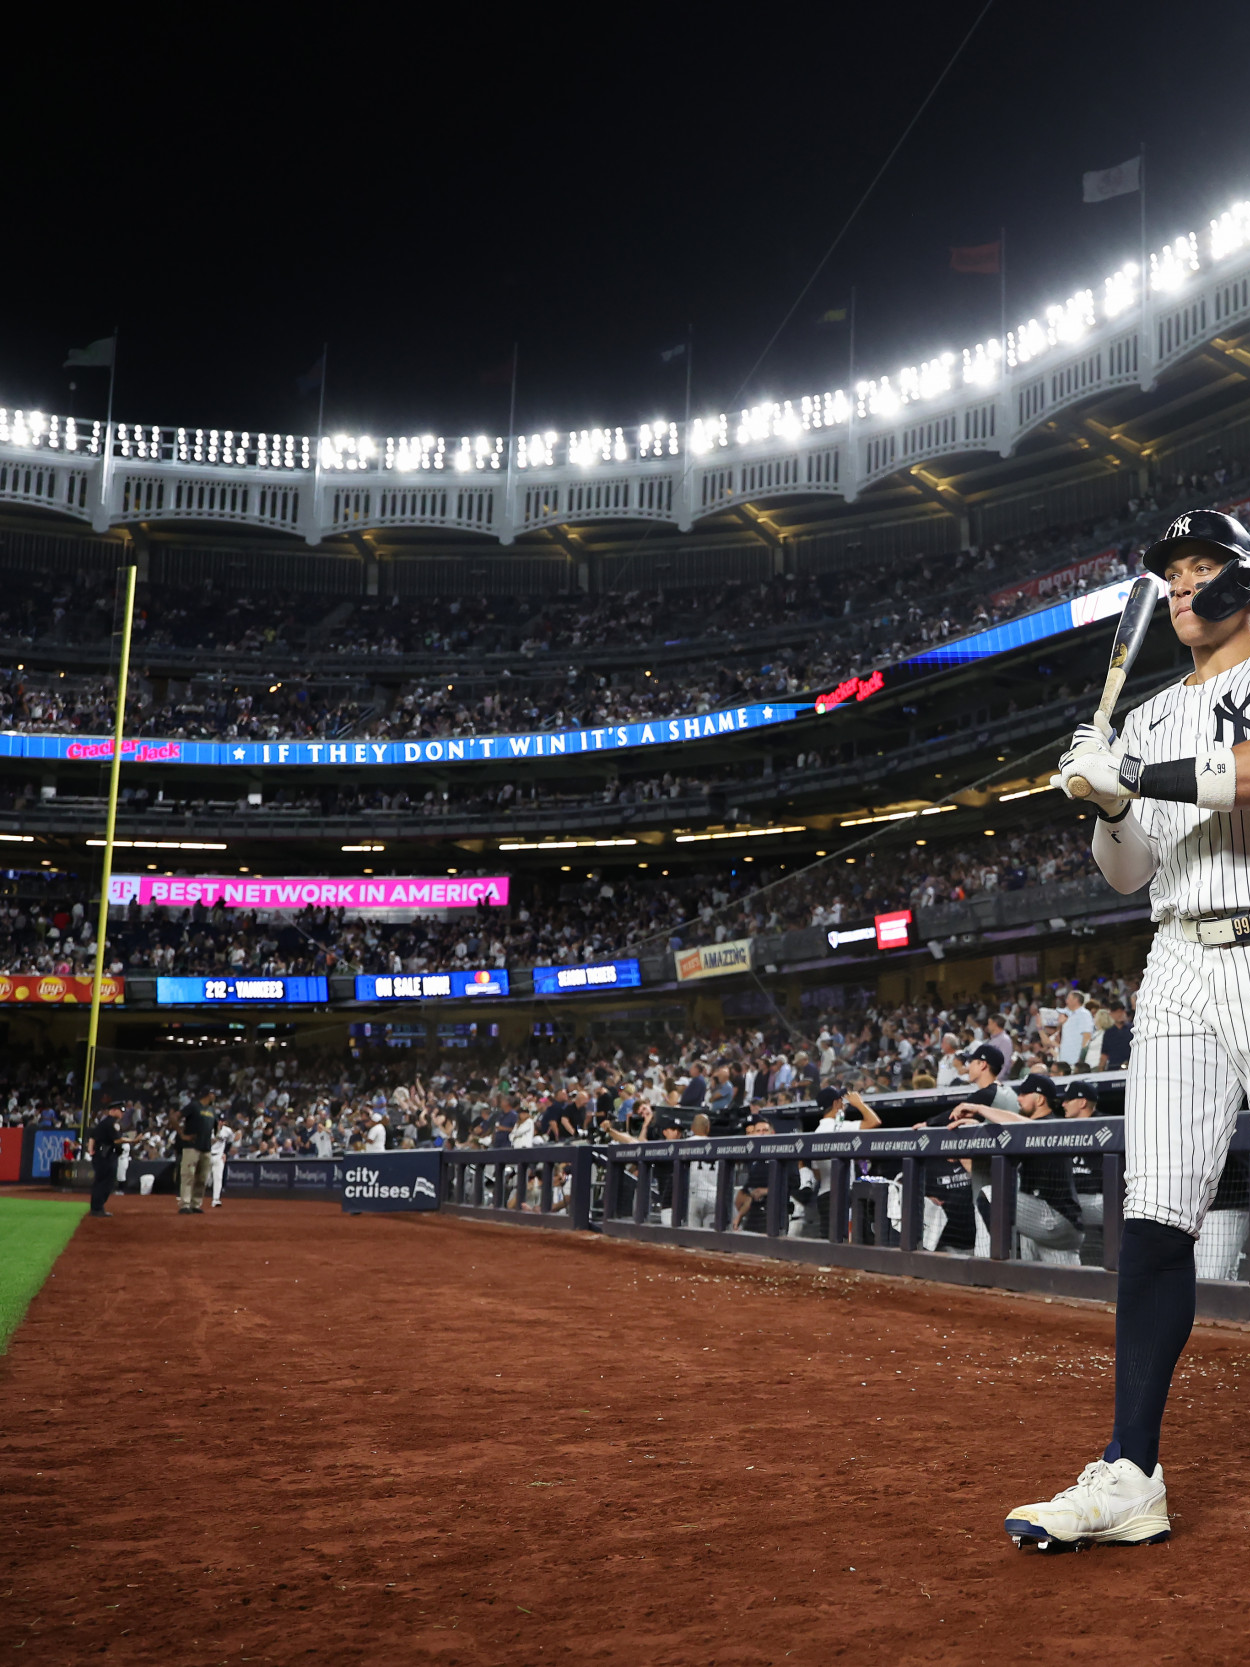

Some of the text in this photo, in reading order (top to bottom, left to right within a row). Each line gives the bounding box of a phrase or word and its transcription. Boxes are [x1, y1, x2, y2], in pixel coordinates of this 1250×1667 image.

[1172, 516, 1192, 538] NY
[263, 707, 749, 763] IF THEY DON'T WIN IT'S A SHAME
[134, 742, 180, 762] Jack
[1217, 763, 1226, 774] 99
[151, 882, 500, 903] BEST NETWORK IN AMERICA
[1234, 917, 1250, 935] 99
[704, 947, 747, 969] AMAZING
[205, 981, 226, 998] 212
[236, 981, 283, 998] YANKEES
[376, 977, 392, 997] ON
[394, 977, 421, 997] SALE
[871, 1142, 884, 1151] BANK
[892, 1141, 917, 1151] AMERICA
[940, 1138, 996, 1150] BANK OF AMERICA
[1025, 1134, 1093, 1147] BANK OF AMERICA
[345, 1167, 379, 1185] city
[345, 1184, 409, 1198] cruises
